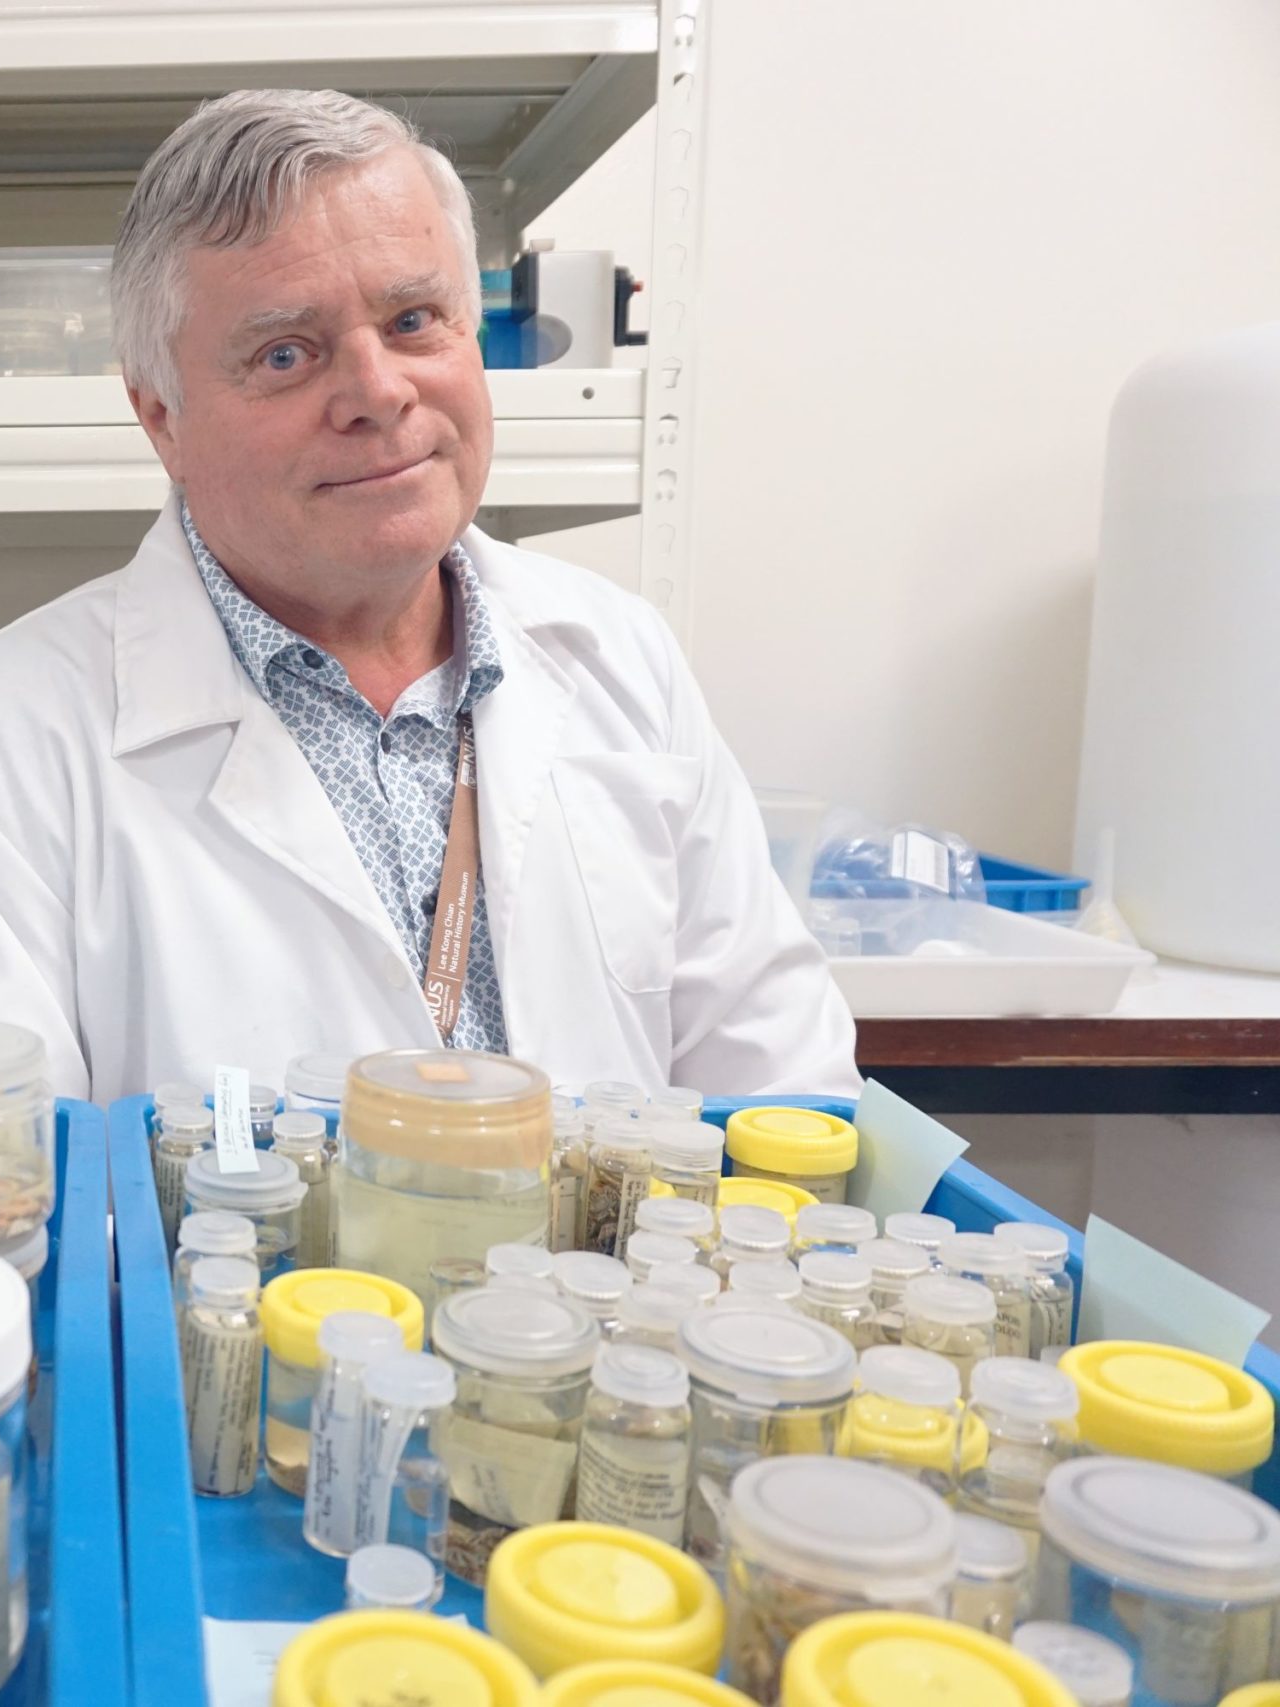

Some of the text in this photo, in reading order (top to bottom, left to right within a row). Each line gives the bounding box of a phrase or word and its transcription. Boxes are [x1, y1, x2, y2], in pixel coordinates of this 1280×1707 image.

[438, 903, 455, 970] Lee Kong Chian
[449, 871, 469, 973] Natural History Museum
[428, 980, 444, 1025] NUS
